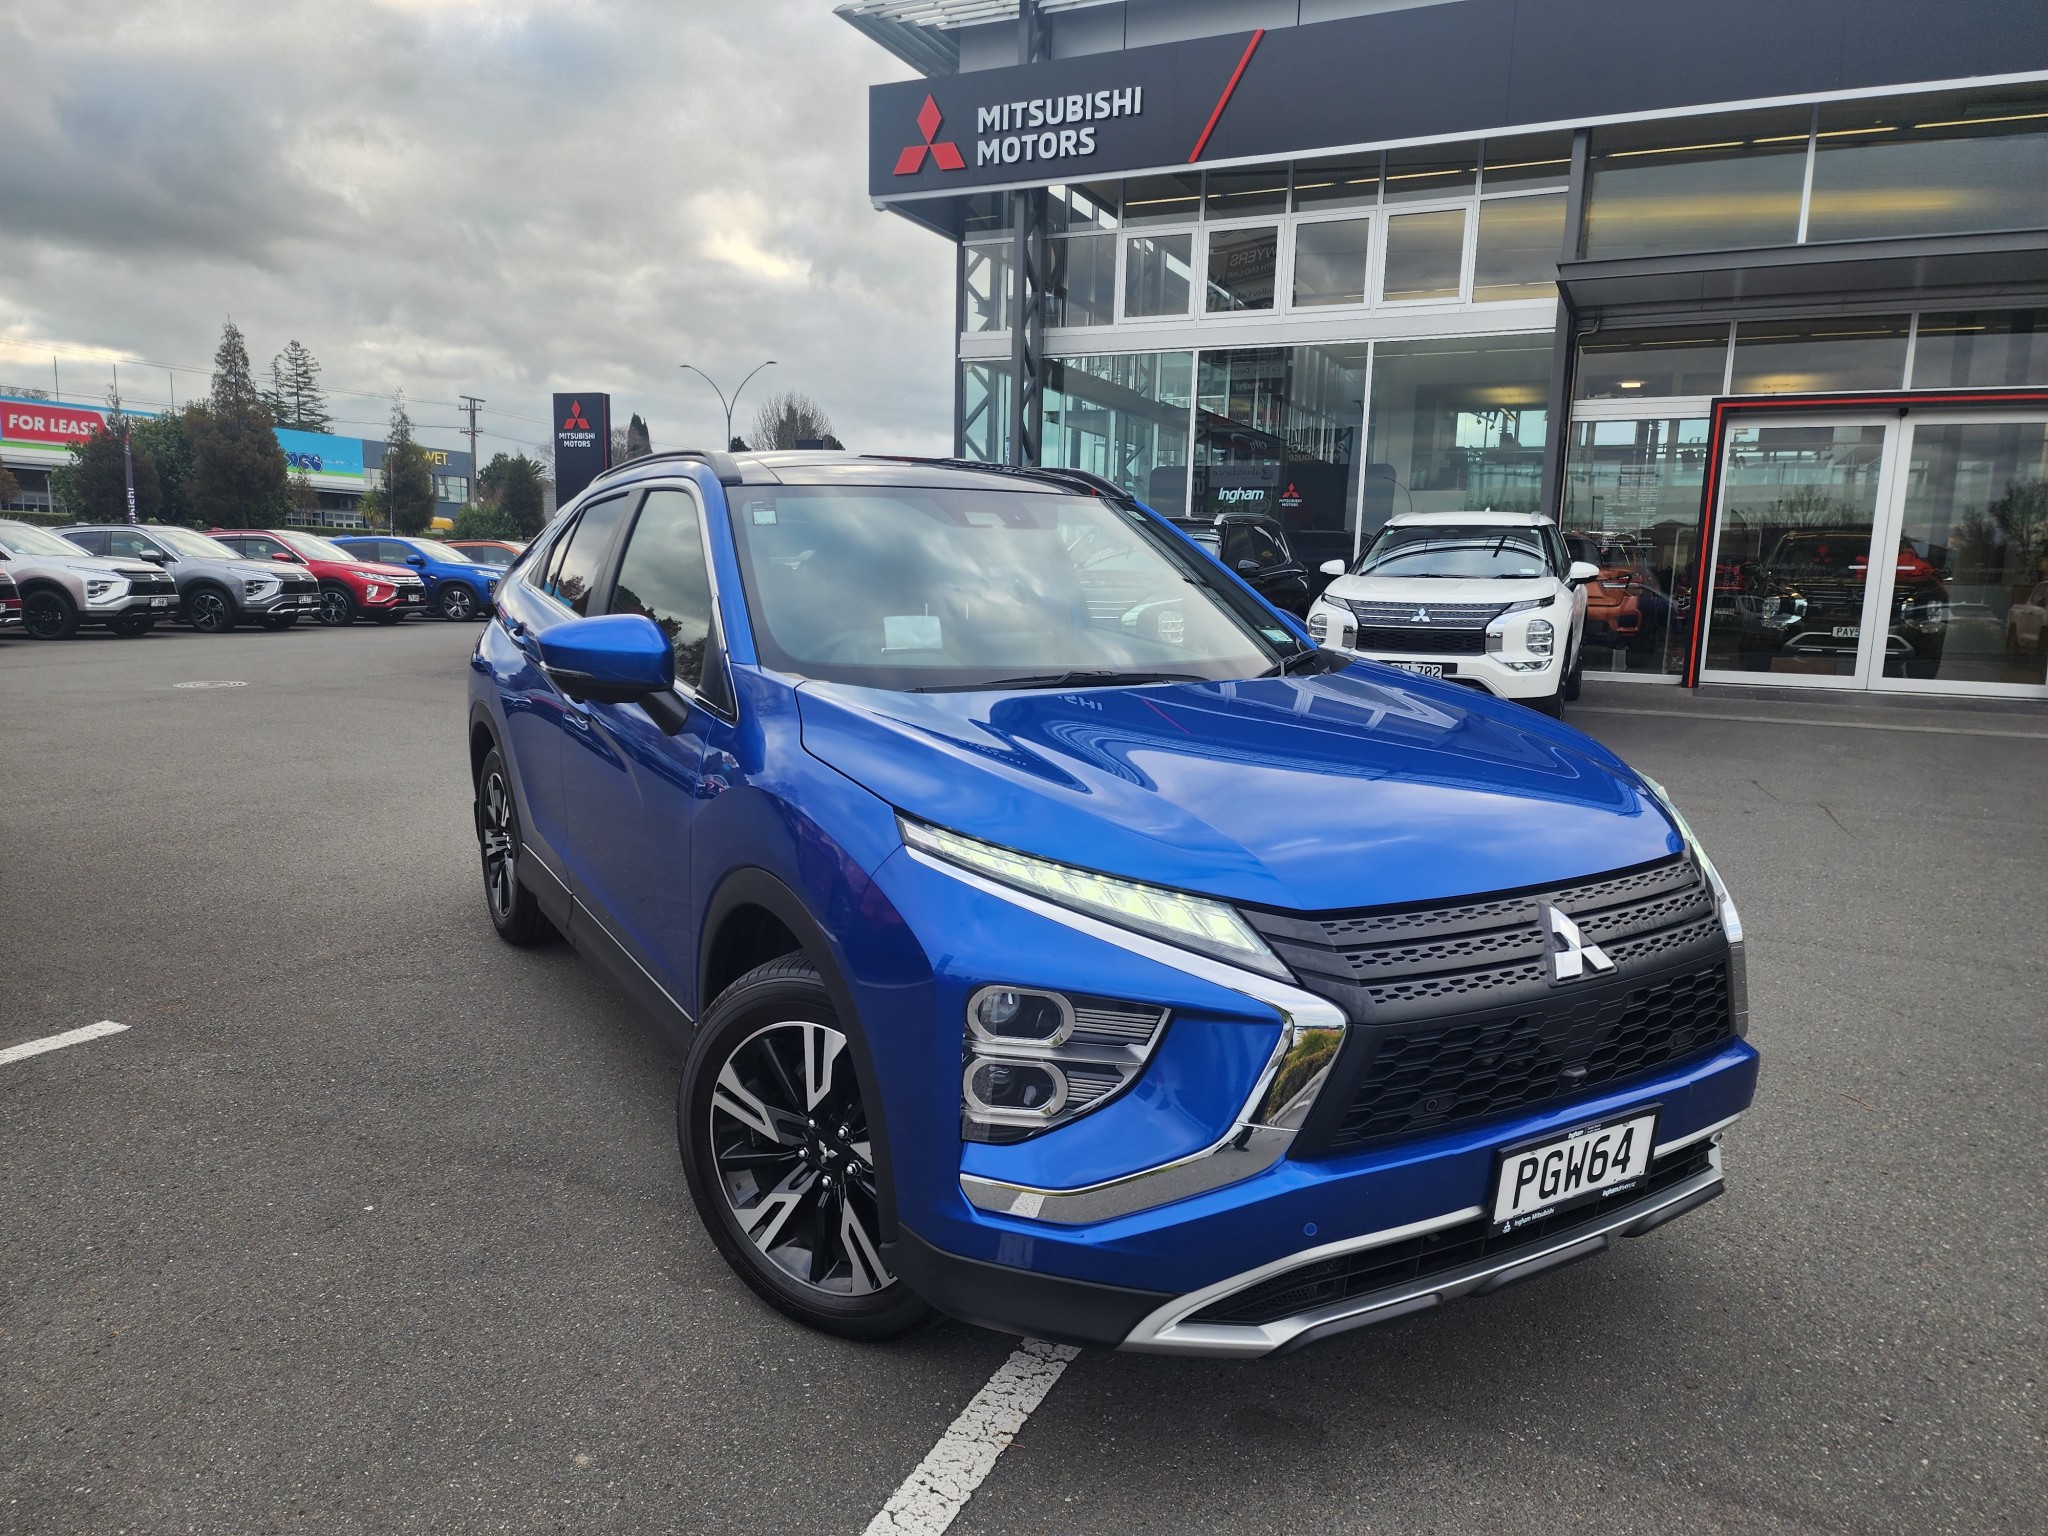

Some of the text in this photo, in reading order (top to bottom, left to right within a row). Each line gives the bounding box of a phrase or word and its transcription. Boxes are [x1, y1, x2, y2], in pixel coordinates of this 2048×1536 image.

[977, 86, 1142, 133] MITSUBISHI
[976, 127, 1096, 167] MOTORS
[9, 414, 98, 436] FOR LEASE
[558, 432, 596, 440] MITSUBISHI
[563, 440, 591, 448] MOTORS
[1218, 487, 1265, 504] Ingham
[1512, 1127, 1635, 1210] PGW64
[1514, 1206, 1556, 1227] Ingham Mitsubishi
